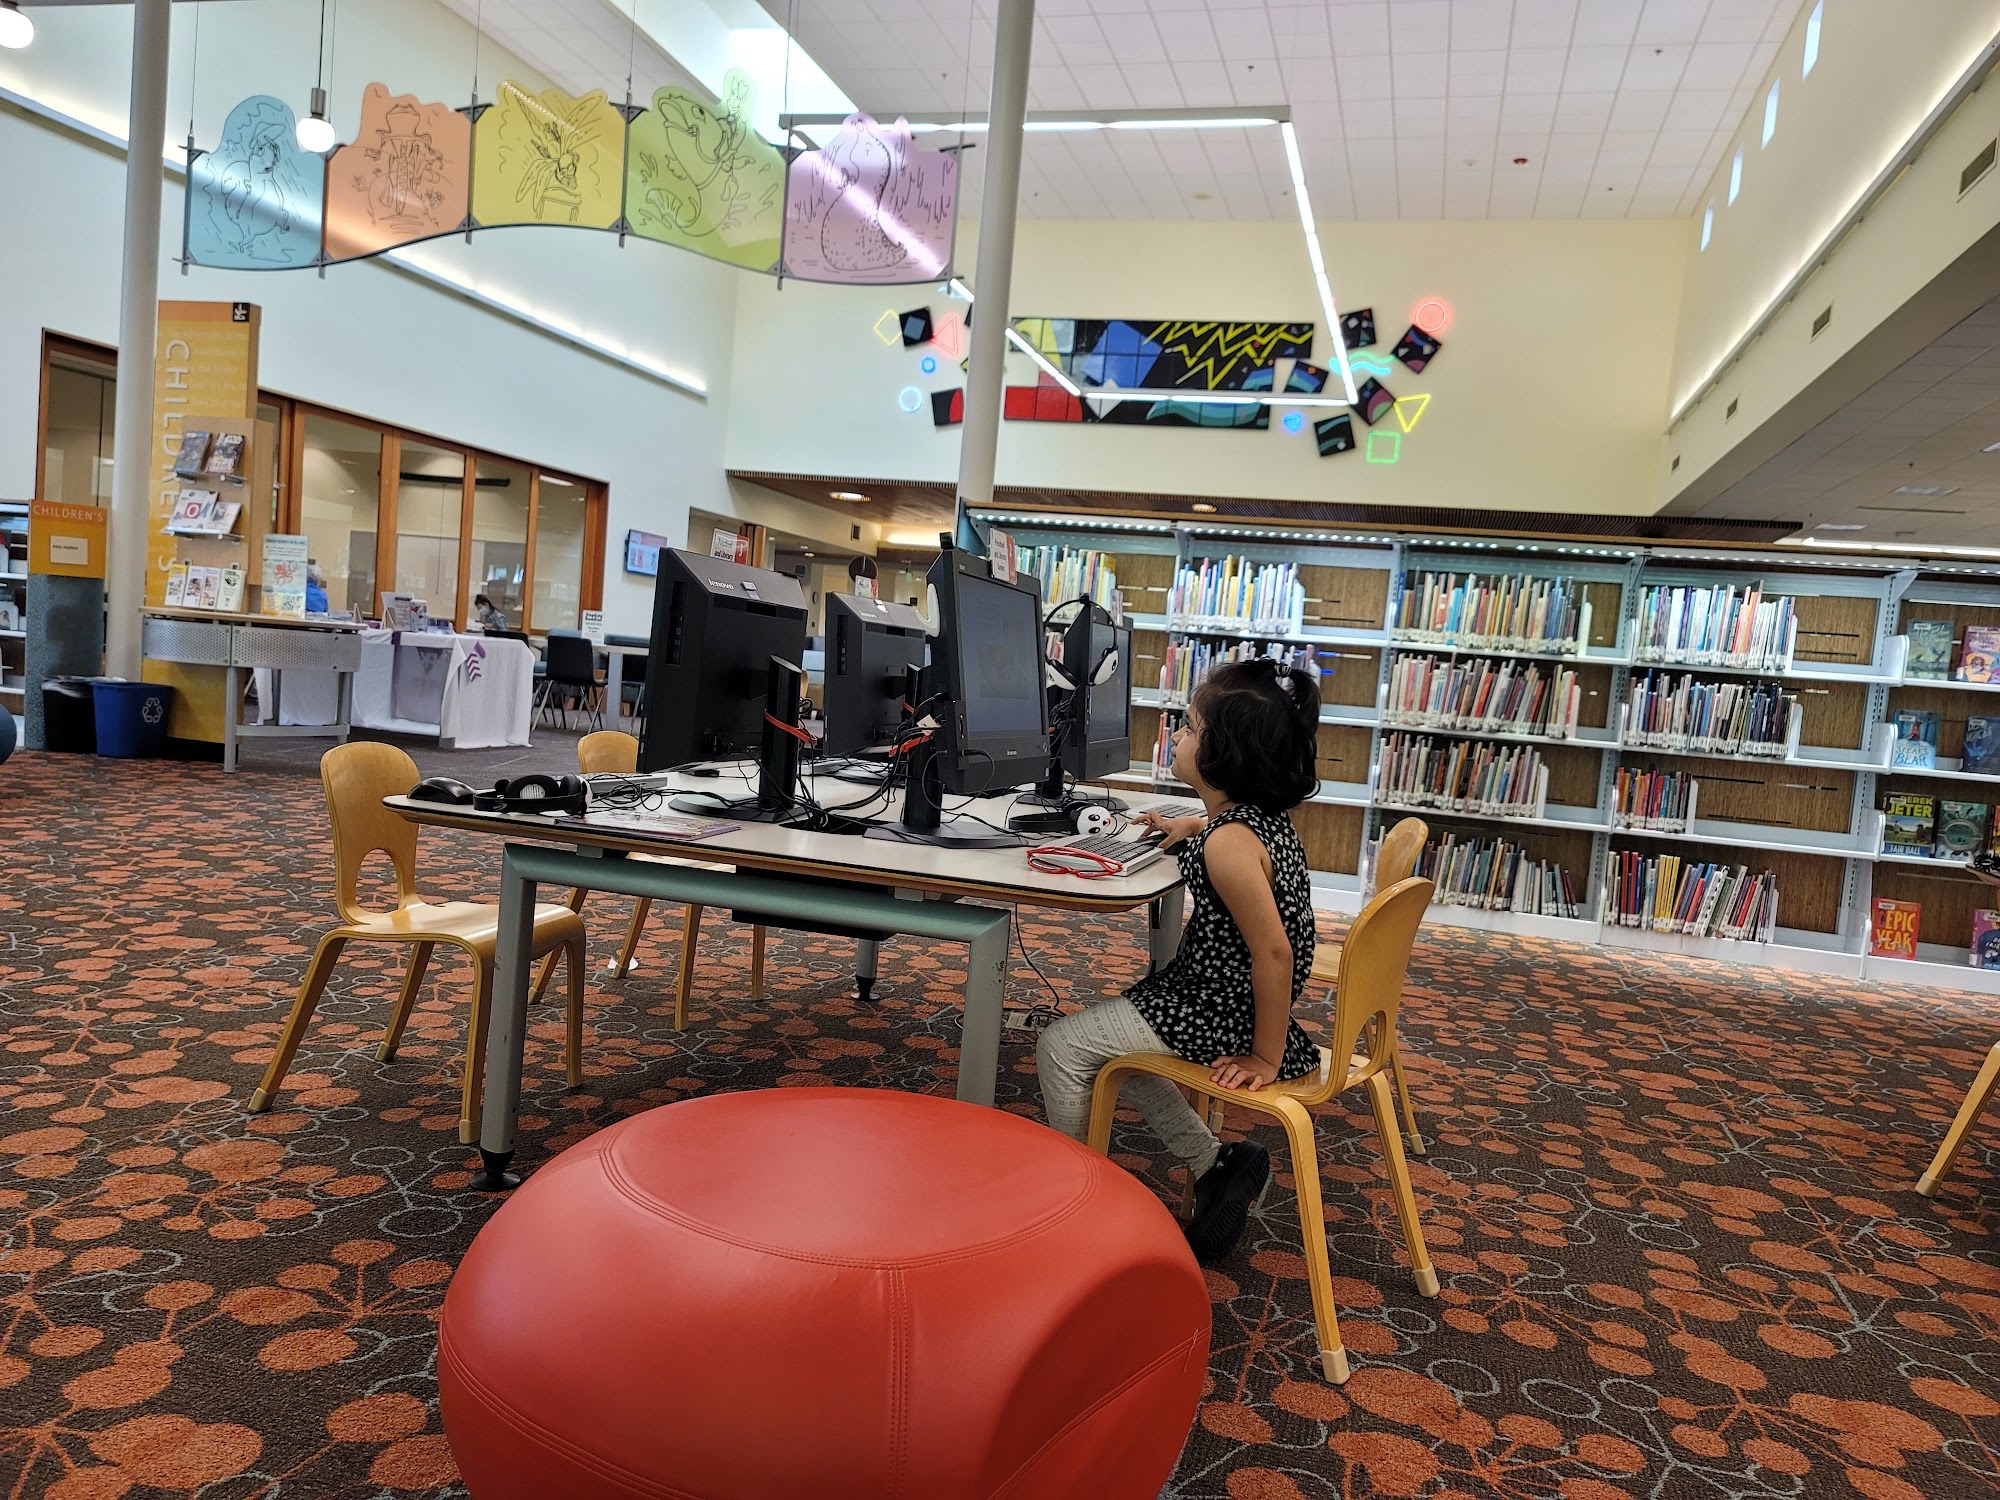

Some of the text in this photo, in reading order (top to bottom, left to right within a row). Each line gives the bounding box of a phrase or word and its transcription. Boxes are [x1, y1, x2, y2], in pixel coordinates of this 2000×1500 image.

[158, 339, 190, 572] CHILDES
[33, 504, 104, 523] CHILDREN'S
[708, 578, 734, 590] lenovo
[1894, 753, 1928, 767] BEAR
[1887, 802, 1933, 818] JETER
[1905, 845, 1921, 855] BALL
[1886, 910, 1917, 932] EPIC
[1876, 929, 1913, 954] YEAR
